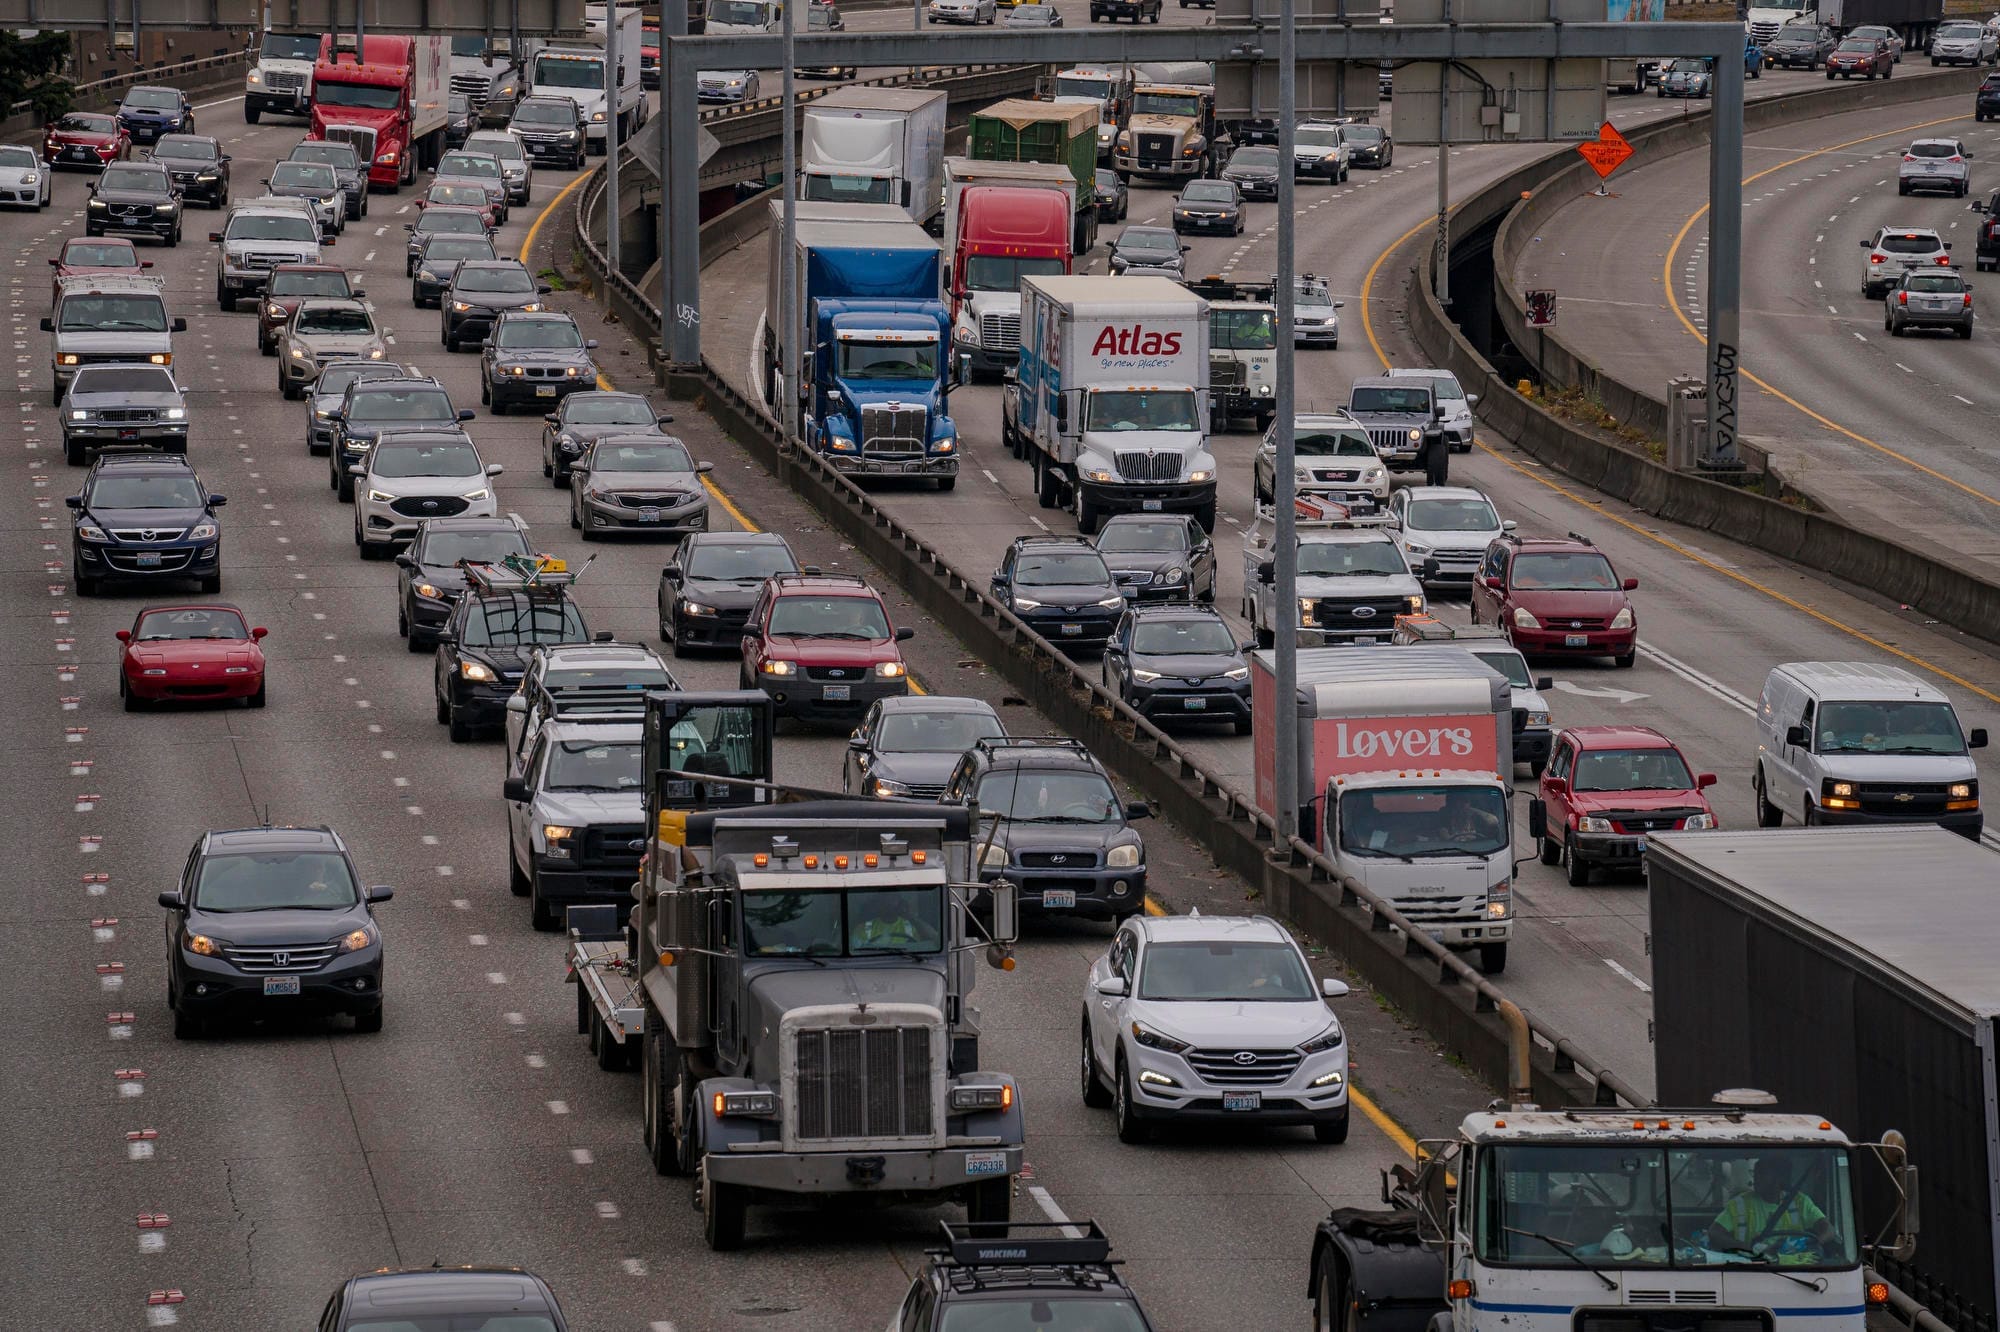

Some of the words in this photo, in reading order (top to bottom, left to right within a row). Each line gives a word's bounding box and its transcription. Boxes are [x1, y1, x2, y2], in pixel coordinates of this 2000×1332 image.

[1091, 325, 1183, 356] Atlas
[1101, 358, 1112, 369] go
[1115, 359, 1135, 367] new
[979, 1249, 1027, 1259] YAKIMA
